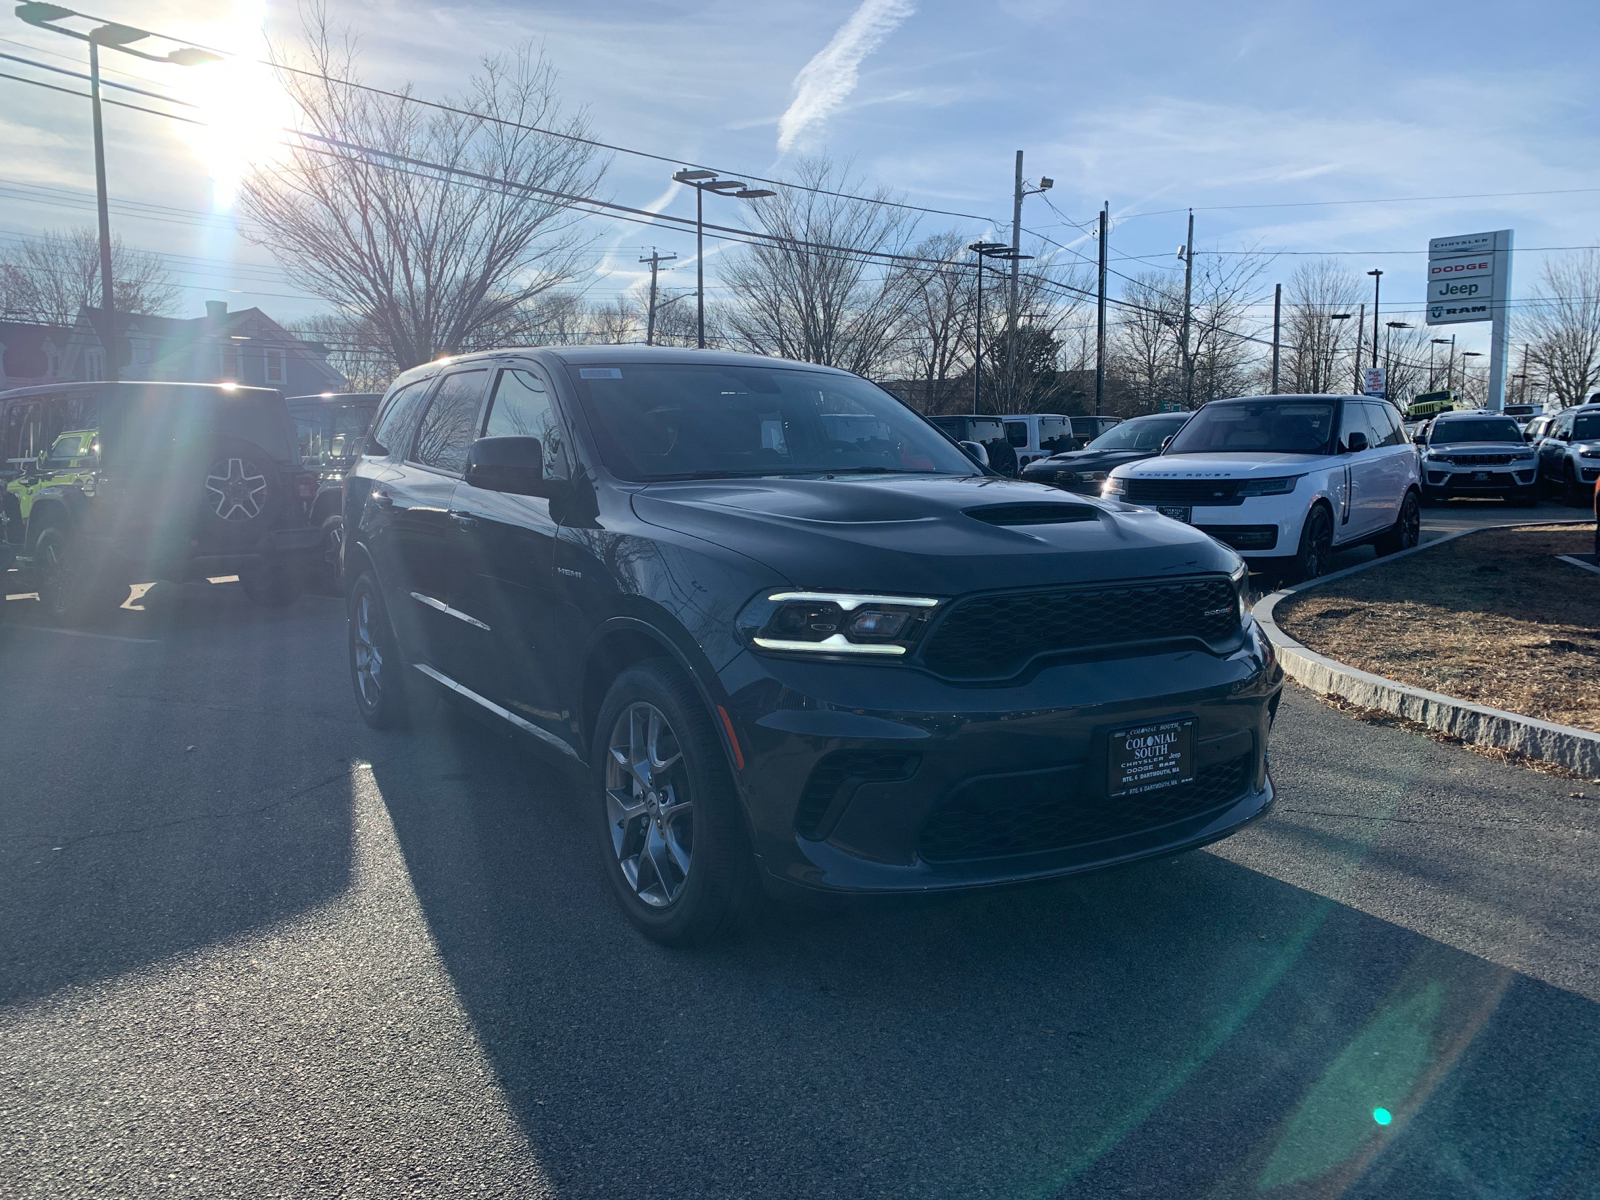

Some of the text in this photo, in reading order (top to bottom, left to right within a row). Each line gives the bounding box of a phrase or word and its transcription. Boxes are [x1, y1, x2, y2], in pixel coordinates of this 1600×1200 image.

[1434, 238, 1488, 249] CHRYSLER
[1431, 262, 1489, 274] DODGE
[1438, 282, 1479, 296] Jeep
[1446, 305, 1487, 315] RAM
[557, 566, 582, 579] HEMI
[1204, 608, 1230, 616] DODGE
[1130, 726, 1157, 736] COLONIAL
[1159, 722, 1180, 731] SOUTH
[1125, 732, 1178, 750] COLONIAL
[1134, 743, 1168, 760] SOUTH
[1121, 752, 1181, 768] CHRYSLER Jeep
[1126, 760, 1176, 774] DODGE RAM
[1122, 775, 1134, 783] RTE.
[1140, 768, 1172, 779] DARTMOUTH,
